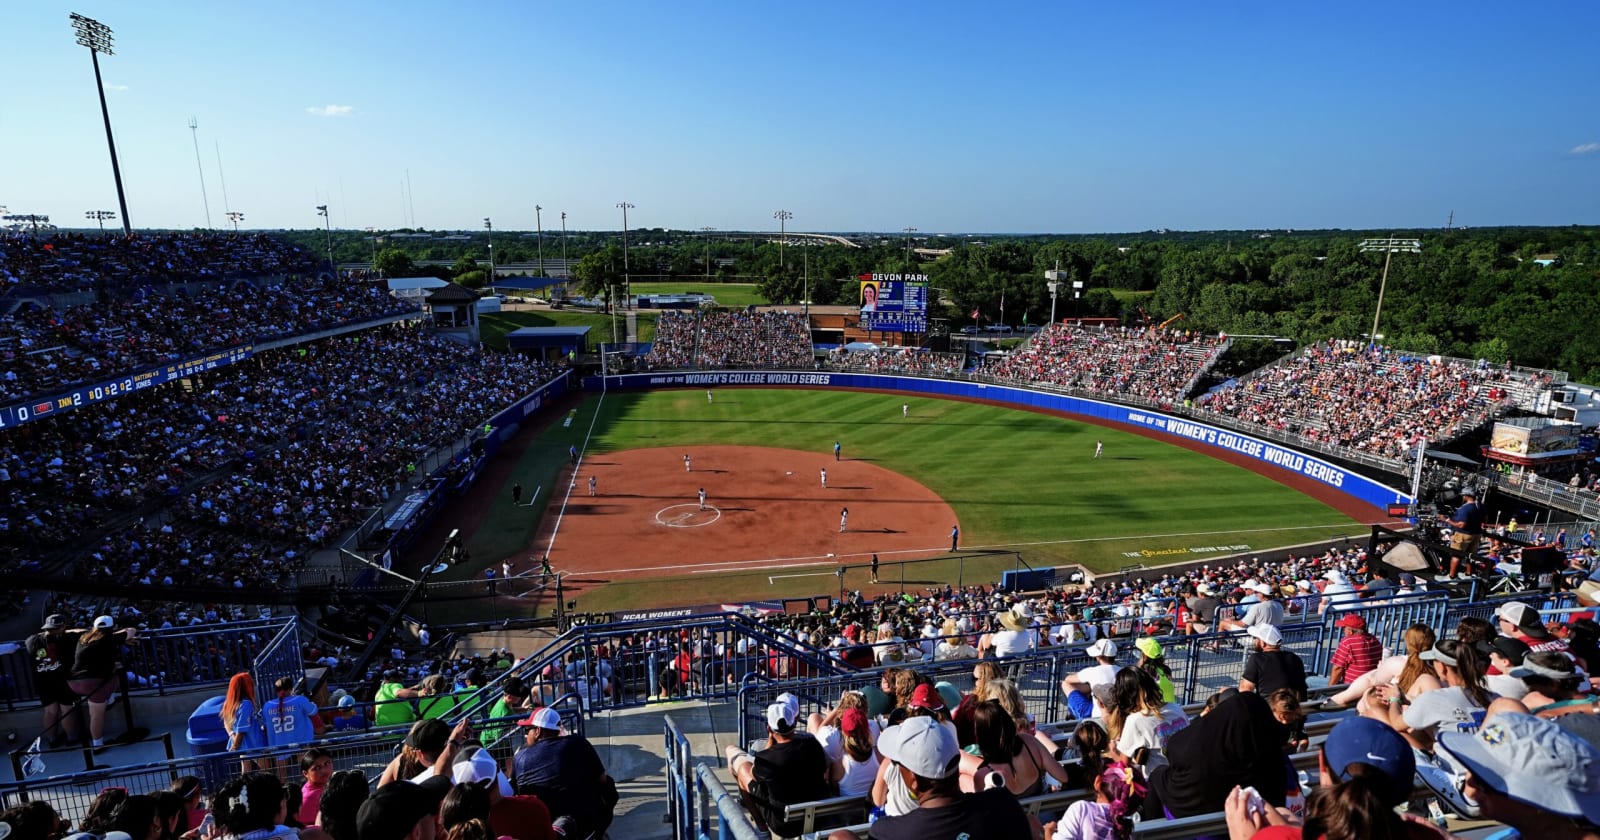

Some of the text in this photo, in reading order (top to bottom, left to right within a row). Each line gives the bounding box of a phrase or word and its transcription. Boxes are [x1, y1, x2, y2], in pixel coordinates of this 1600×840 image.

[872, 273, 929, 282] DEVON PARK
[125, 379, 133, 391] 2
[136, 379, 152, 390] JONES
[685, 374, 728, 385] WOMEN'S
[728, 373, 766, 384] COLLEGE
[767, 373, 798, 384] WORLD
[799, 374, 831, 385] SERIES
[95, 387, 103, 400] 0
[110, 382, 118, 396] 2
[58, 392, 82, 409] INN 2
[18, 406, 29, 421] 0
[1128, 412, 1344, 487] HOME OF THE WOMEN'S COLLEGE WORLD SERIES
[622, 613, 647, 621] NCAA
[649, 609, 692, 619] WOMEN'S
[272, 715, 295, 734] 22
